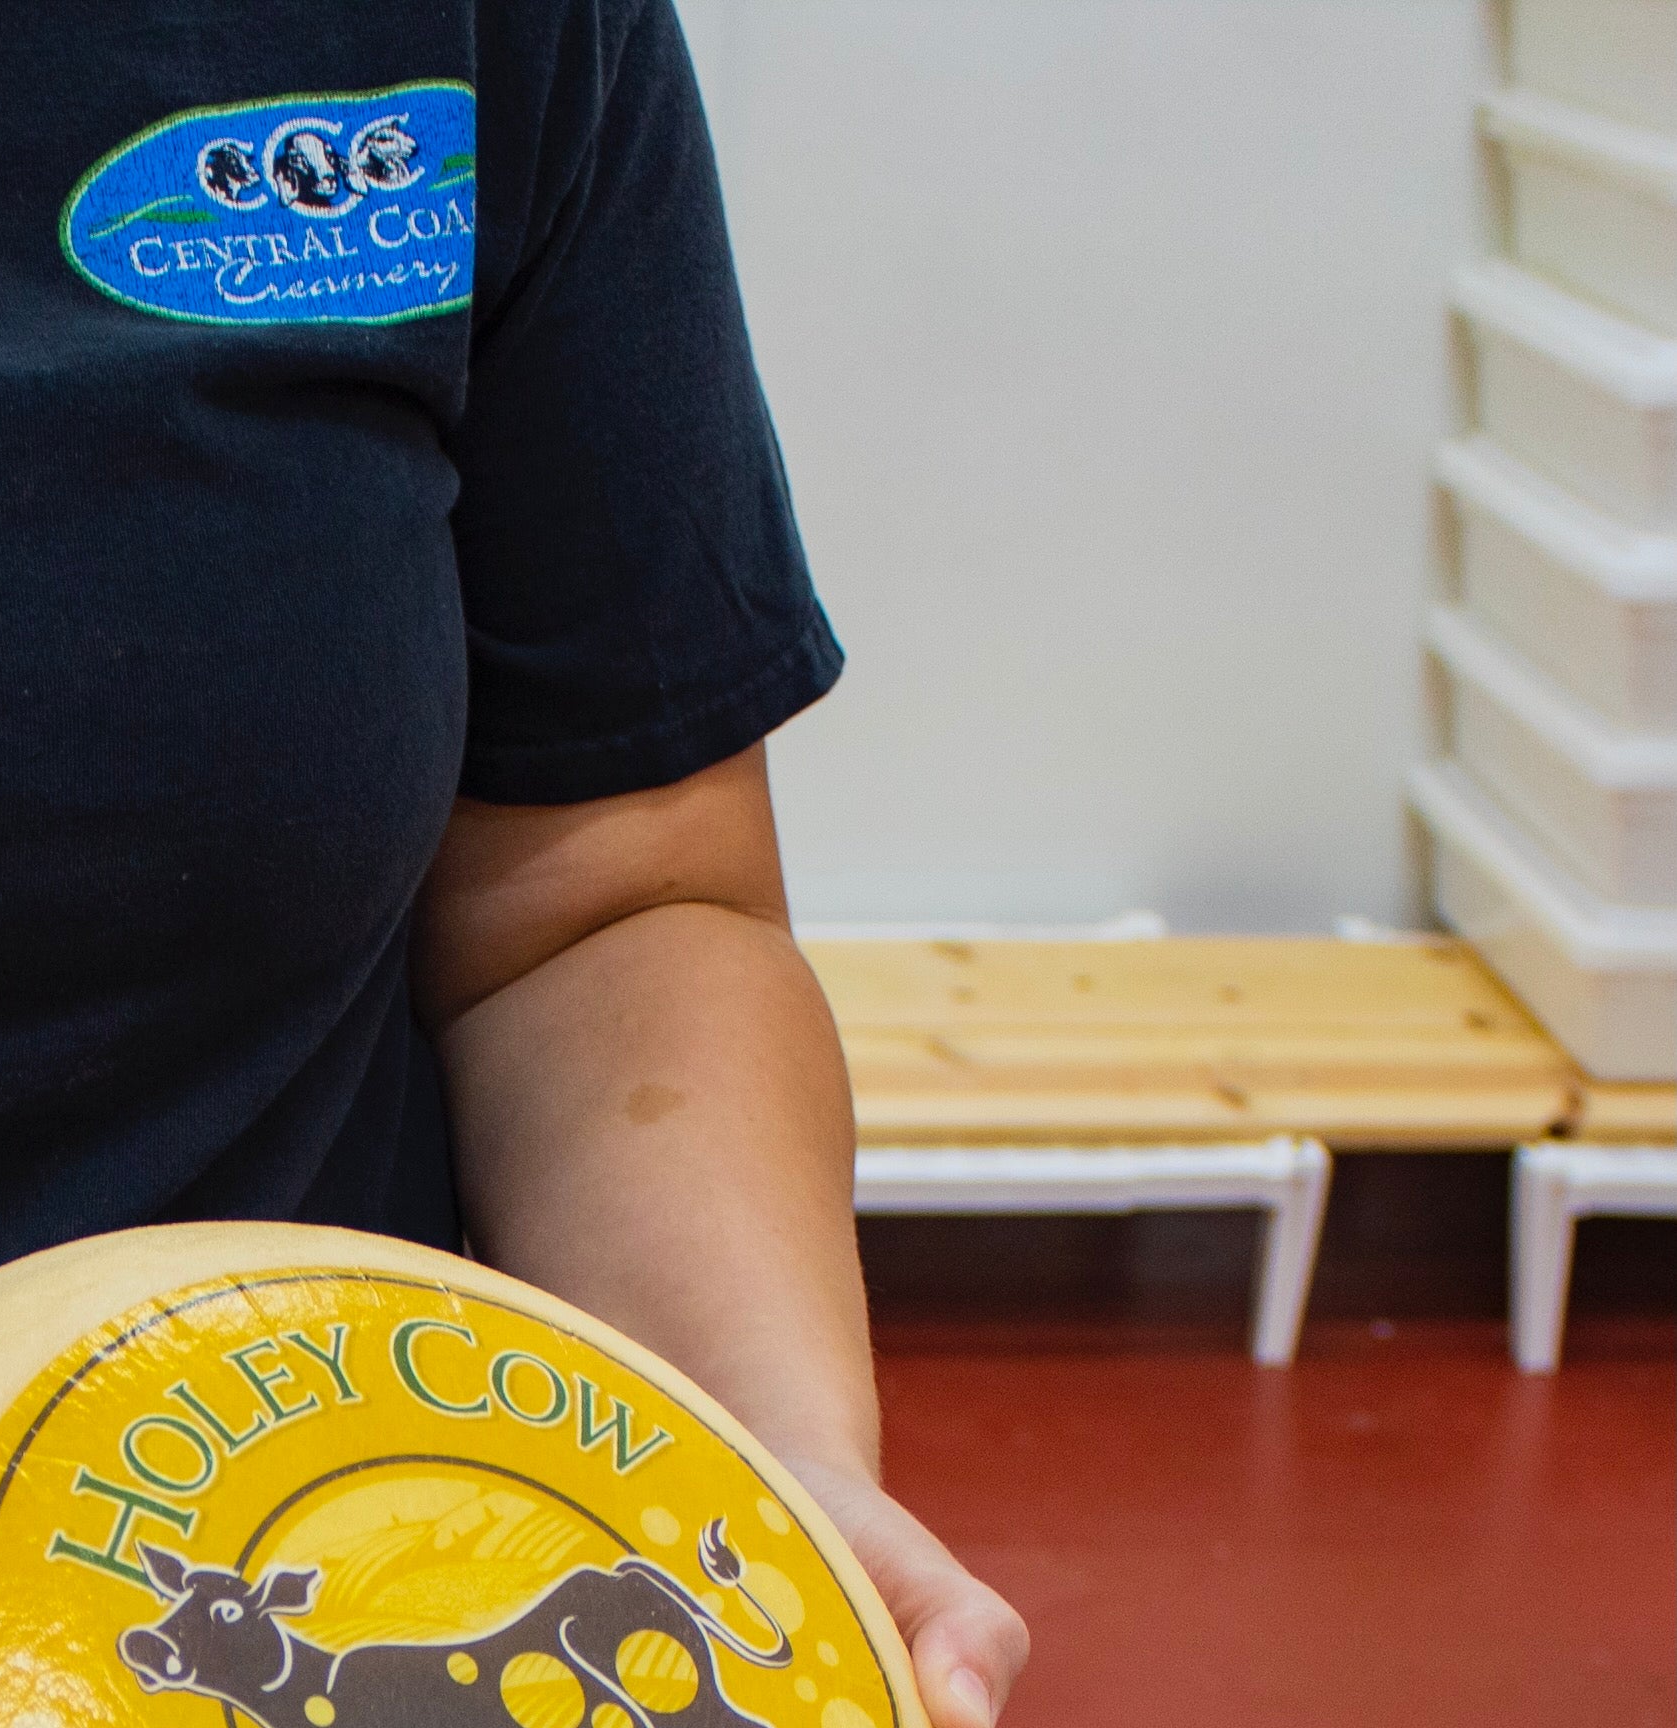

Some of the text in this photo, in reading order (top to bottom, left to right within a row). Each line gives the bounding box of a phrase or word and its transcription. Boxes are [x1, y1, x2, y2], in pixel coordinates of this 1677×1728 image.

[128, 198, 474, 278] CENTRAL COA
[214, 256, 459, 305] Creamery
[45, 1317, 674, 1590] HOLEY COW
